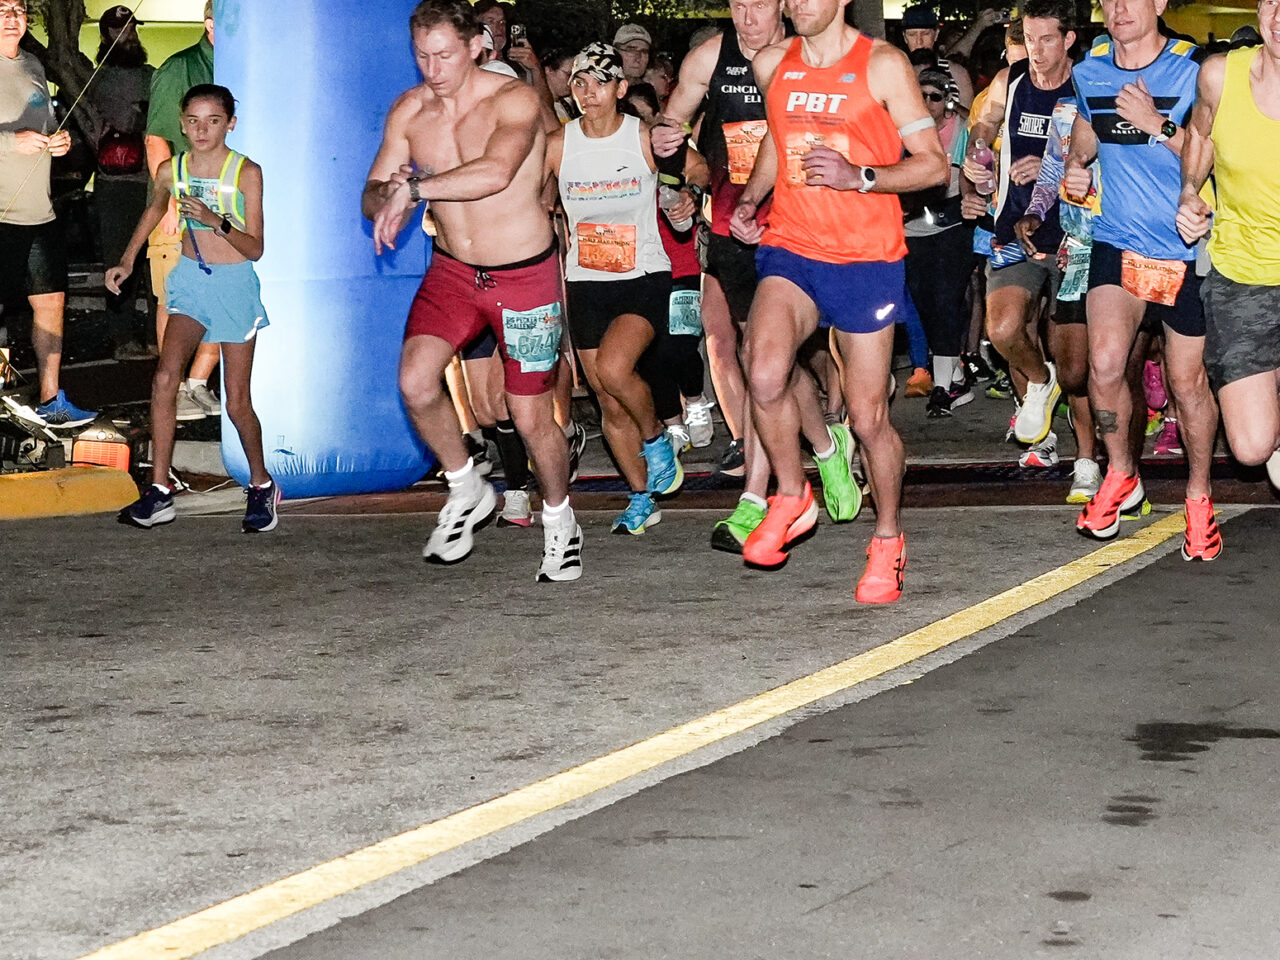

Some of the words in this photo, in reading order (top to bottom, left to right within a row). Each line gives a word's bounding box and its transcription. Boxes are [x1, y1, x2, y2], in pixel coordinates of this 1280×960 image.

[783, 71, 806, 80] PBT
[786, 92, 848, 114] PBT
[1018, 115, 1045, 135] SHORE
